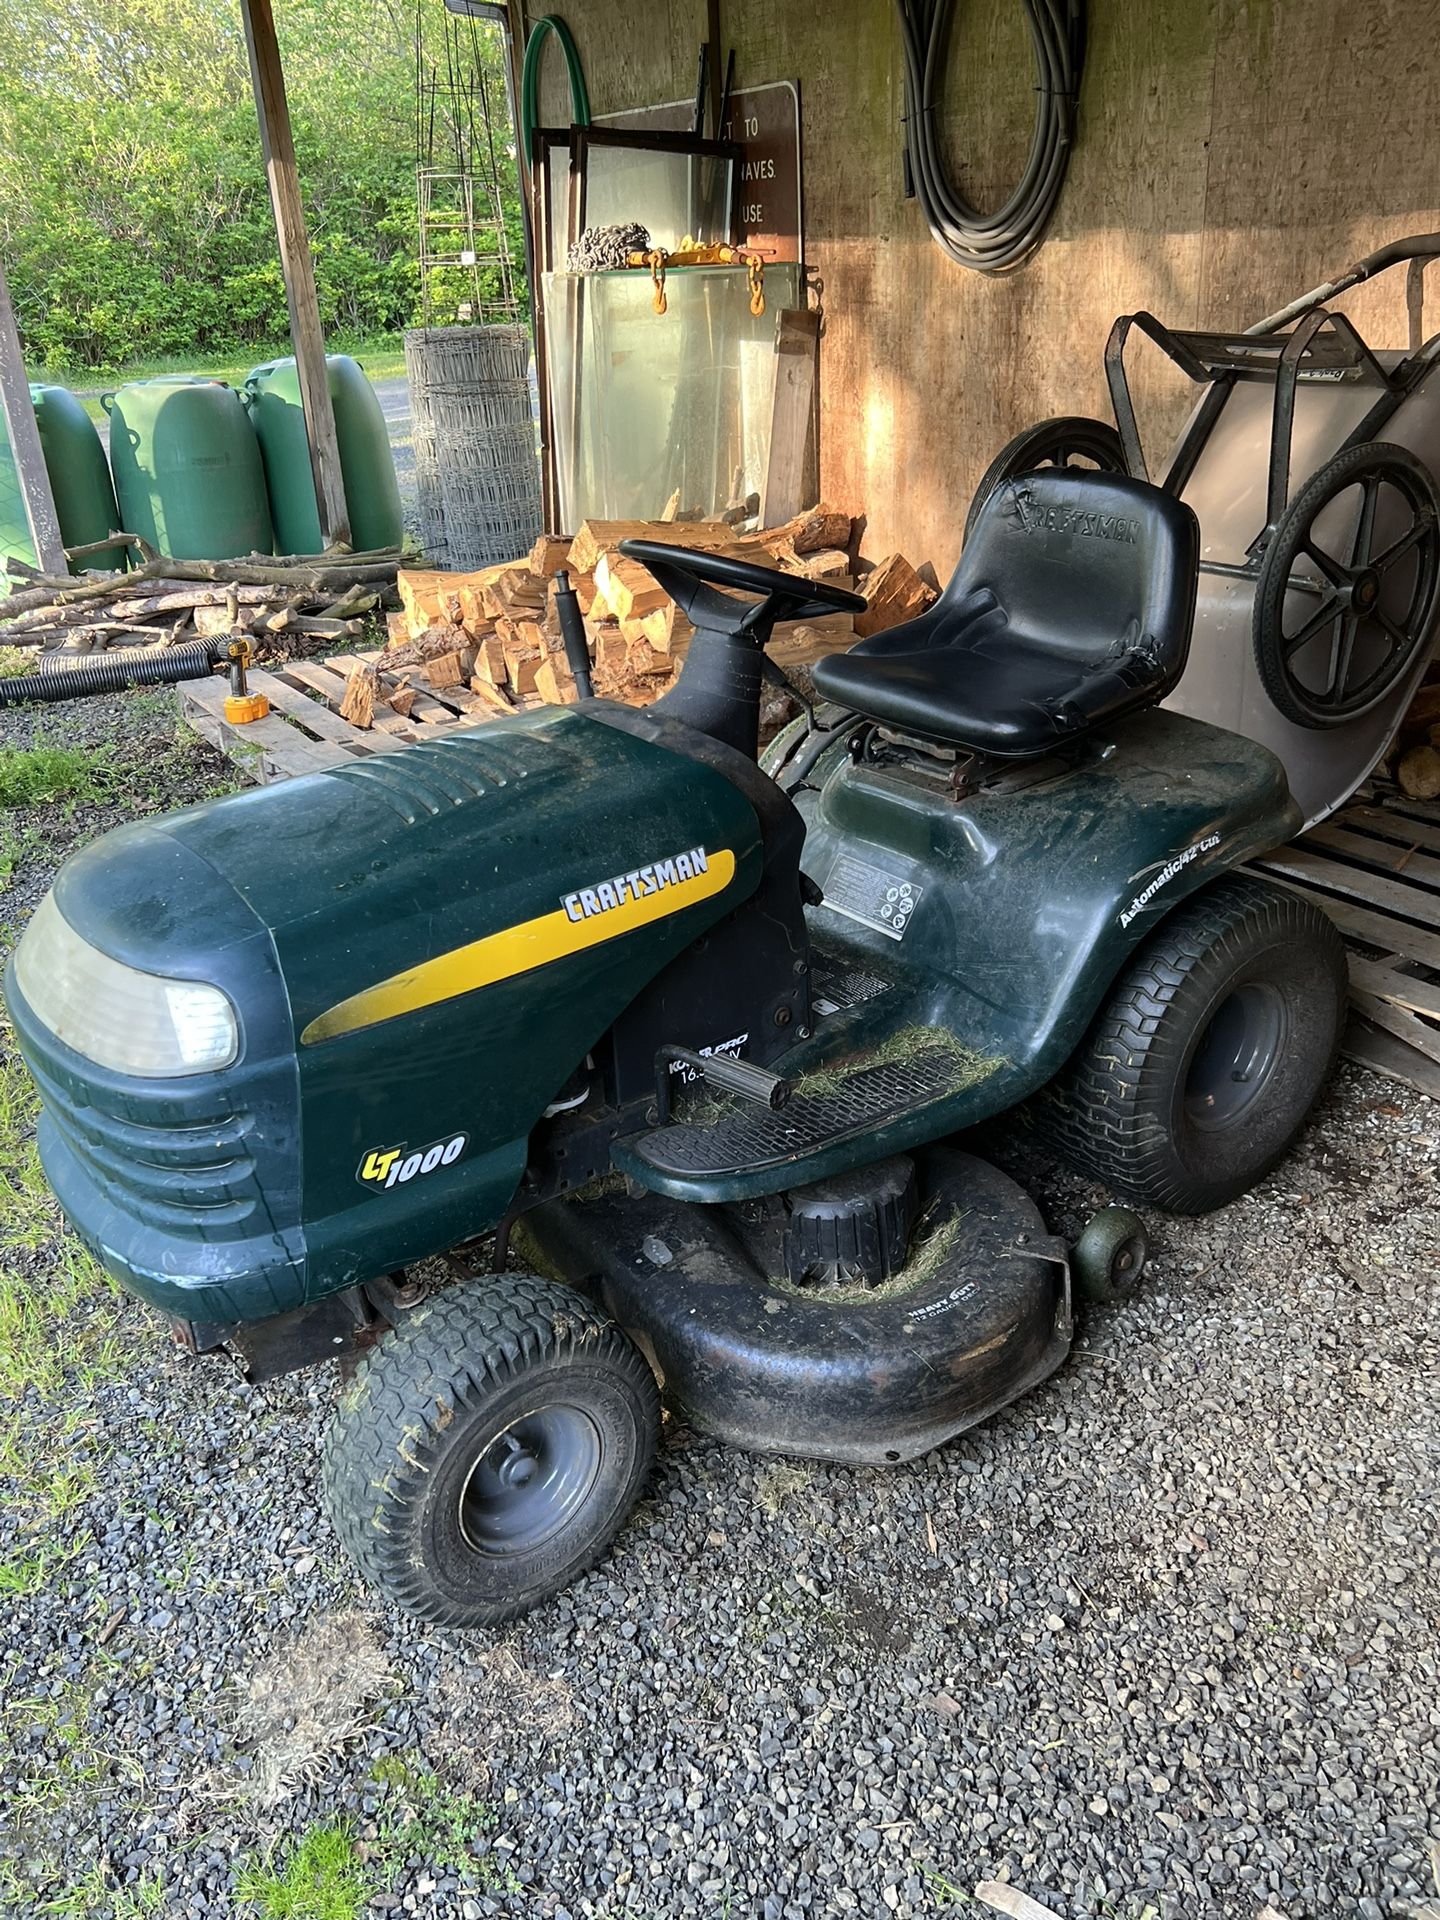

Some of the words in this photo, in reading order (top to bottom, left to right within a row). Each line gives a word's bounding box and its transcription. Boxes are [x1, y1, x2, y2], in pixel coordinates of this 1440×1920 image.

[744, 116, 759, 138] TO
[742, 204, 763, 223] USE
[564, 847, 709, 923] CRAFTSMAN
[714, 1033, 749, 1055] PRO
[362, 1149, 402, 1182] LT
[384, 1136, 466, 1189] 1000
[908, 1298, 949, 1318] HEAVY
